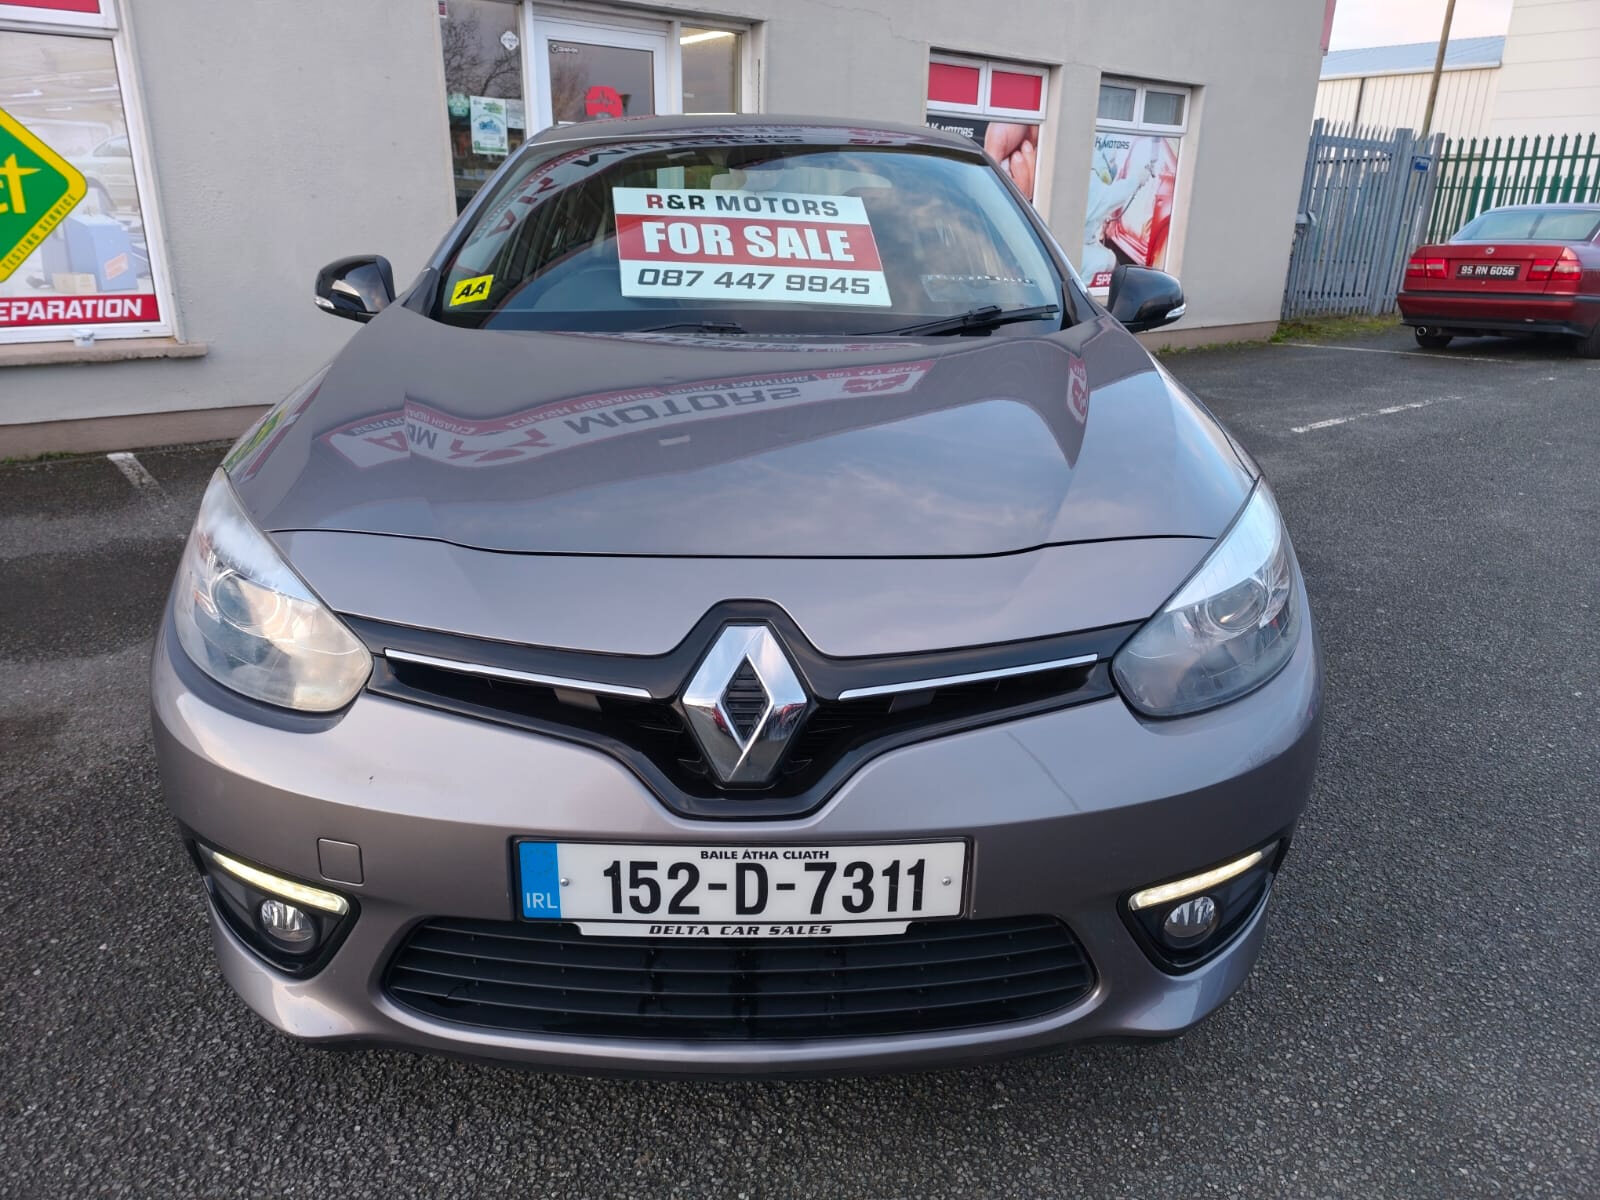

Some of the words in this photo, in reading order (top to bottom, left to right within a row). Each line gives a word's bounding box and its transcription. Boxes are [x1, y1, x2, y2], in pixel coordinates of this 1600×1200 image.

[1102, 139, 1131, 150] MOTORS
[645, 193, 705, 210] R&R
[716, 195, 839, 217] MOTORS
[1, 232, 41, 271] TESTING
[38, 193, 77, 232] SERVICE
[641, 221, 735, 257] FOR
[743, 225, 855, 262] SALE
[1475, 266, 1488, 275] RN
[1490, 266, 1514, 276] 6056
[456, 281, 486, 299] AA
[638, 268, 704, 287] 087
[714, 271, 775, 290] 447
[785, 275, 870, 295] 9945
[700, 850, 738, 860] BAILE
[742, 848, 779, 860] ÁTHA
[783, 849, 829, 860] CLIATH
[602, 857, 926, 916] 152-D-7311
[526, 892, 558, 909] IRL
[649, 924, 710, 936] DELTA
[720, 924, 759, 936] CAR
[768, 924, 832, 936] SALES
